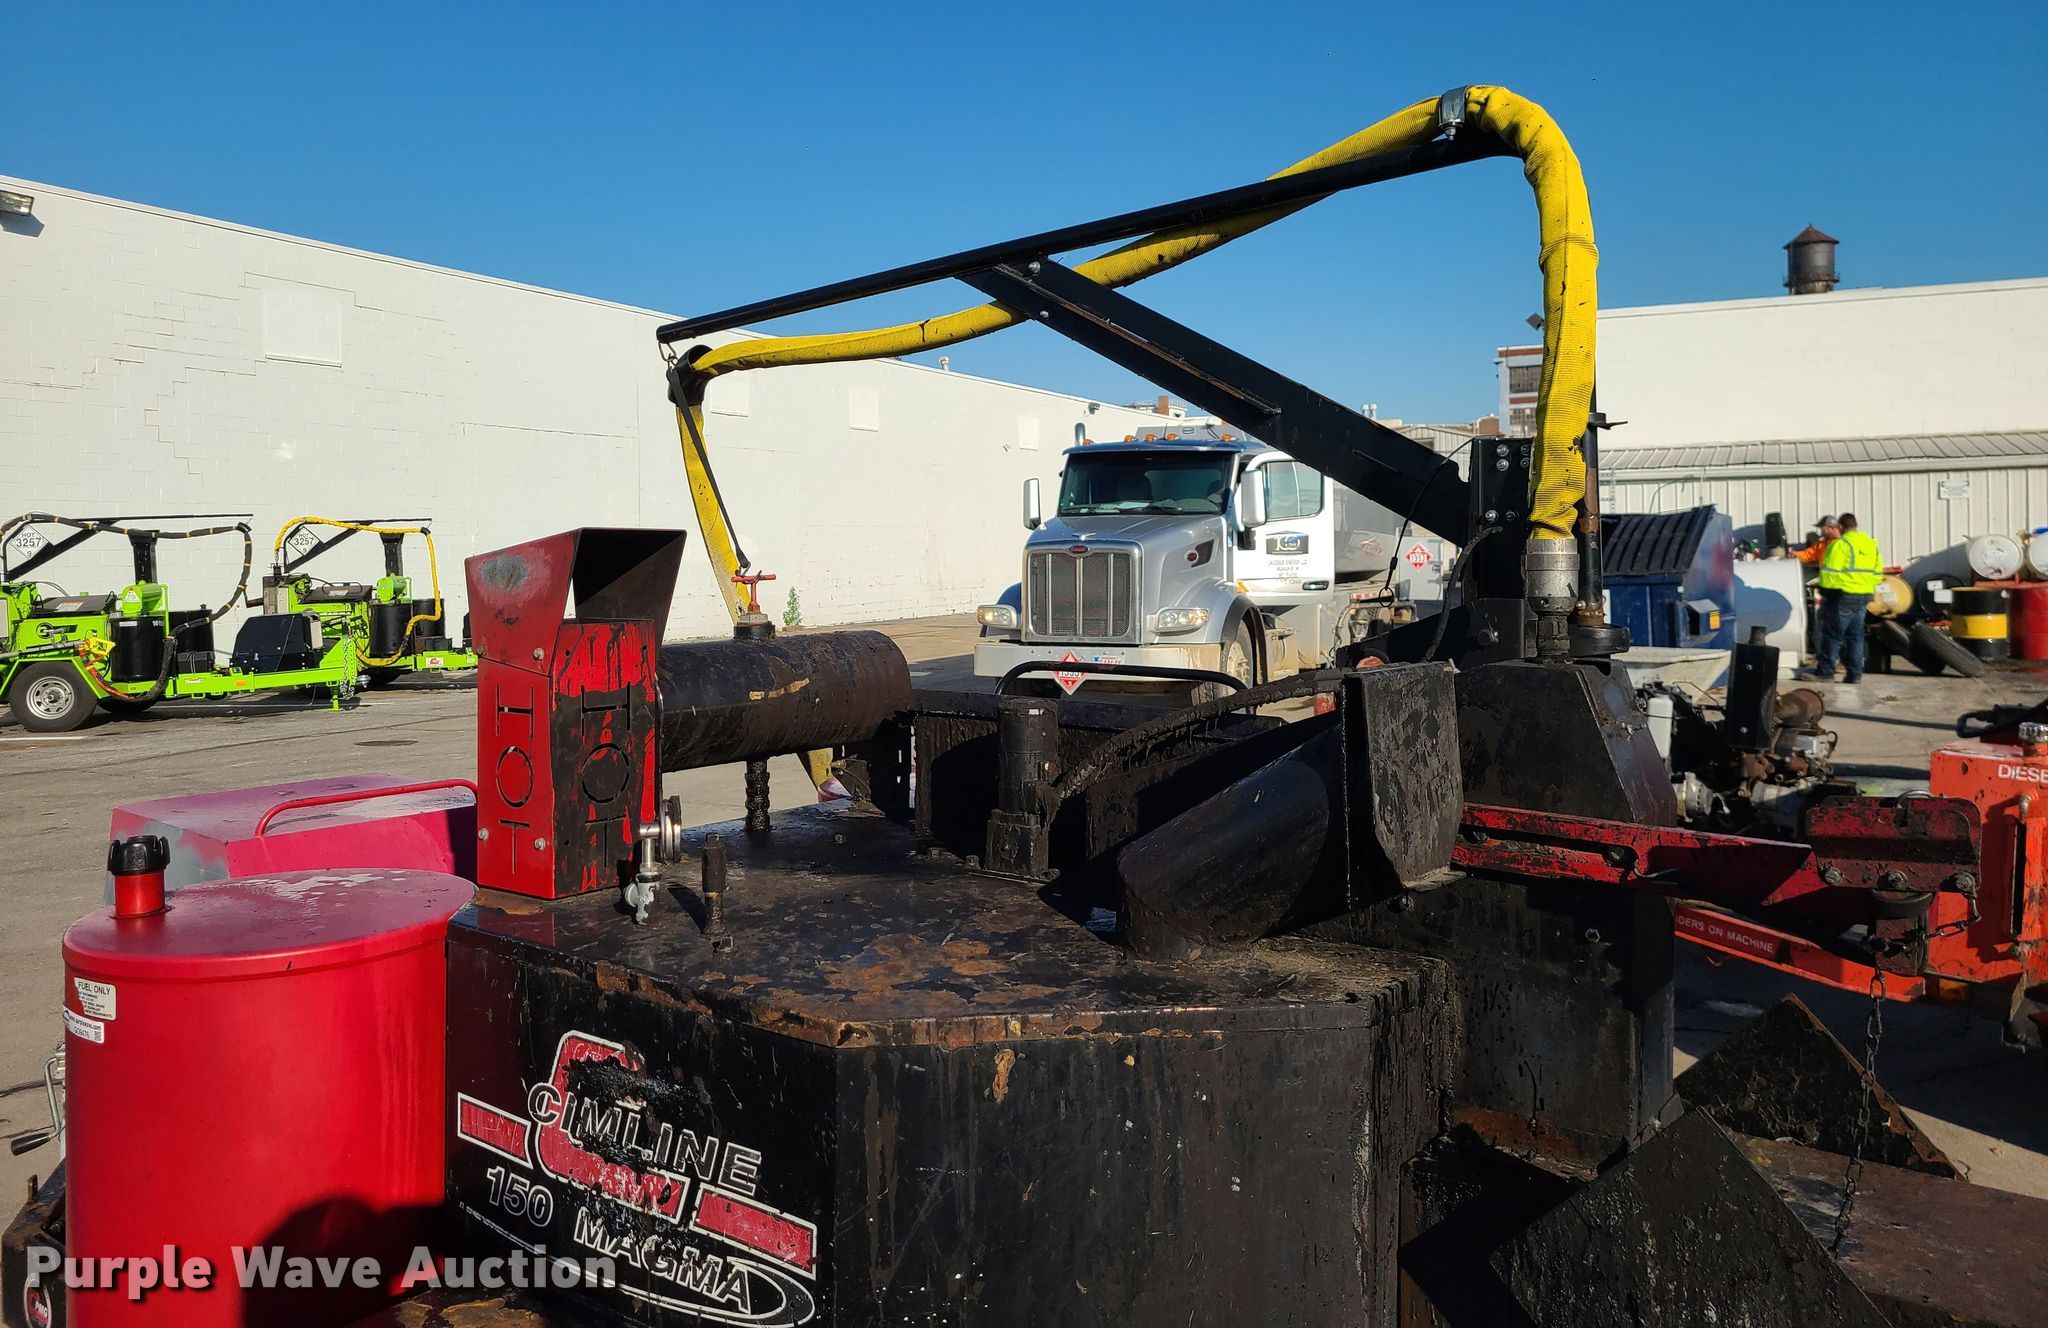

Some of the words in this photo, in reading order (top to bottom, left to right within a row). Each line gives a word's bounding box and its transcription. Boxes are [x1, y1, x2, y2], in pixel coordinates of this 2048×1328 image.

[16, 538, 41, 547] 3257
[294, 538, 314, 546] 3257
[1997, 764, 2048, 784] DIESE
[1675, 915, 1705, 931] IDERS
[1708, 925, 1723, 937] ON
[1727, 931, 1774, 953] MACHINE
[78, 981, 92, 992] FUEL
[93, 985, 111, 995] ONLY
[528, 1082, 762, 1197] CIMLINE
[486, 1165, 554, 1228] 150
[573, 1206, 751, 1315] MAGMA
